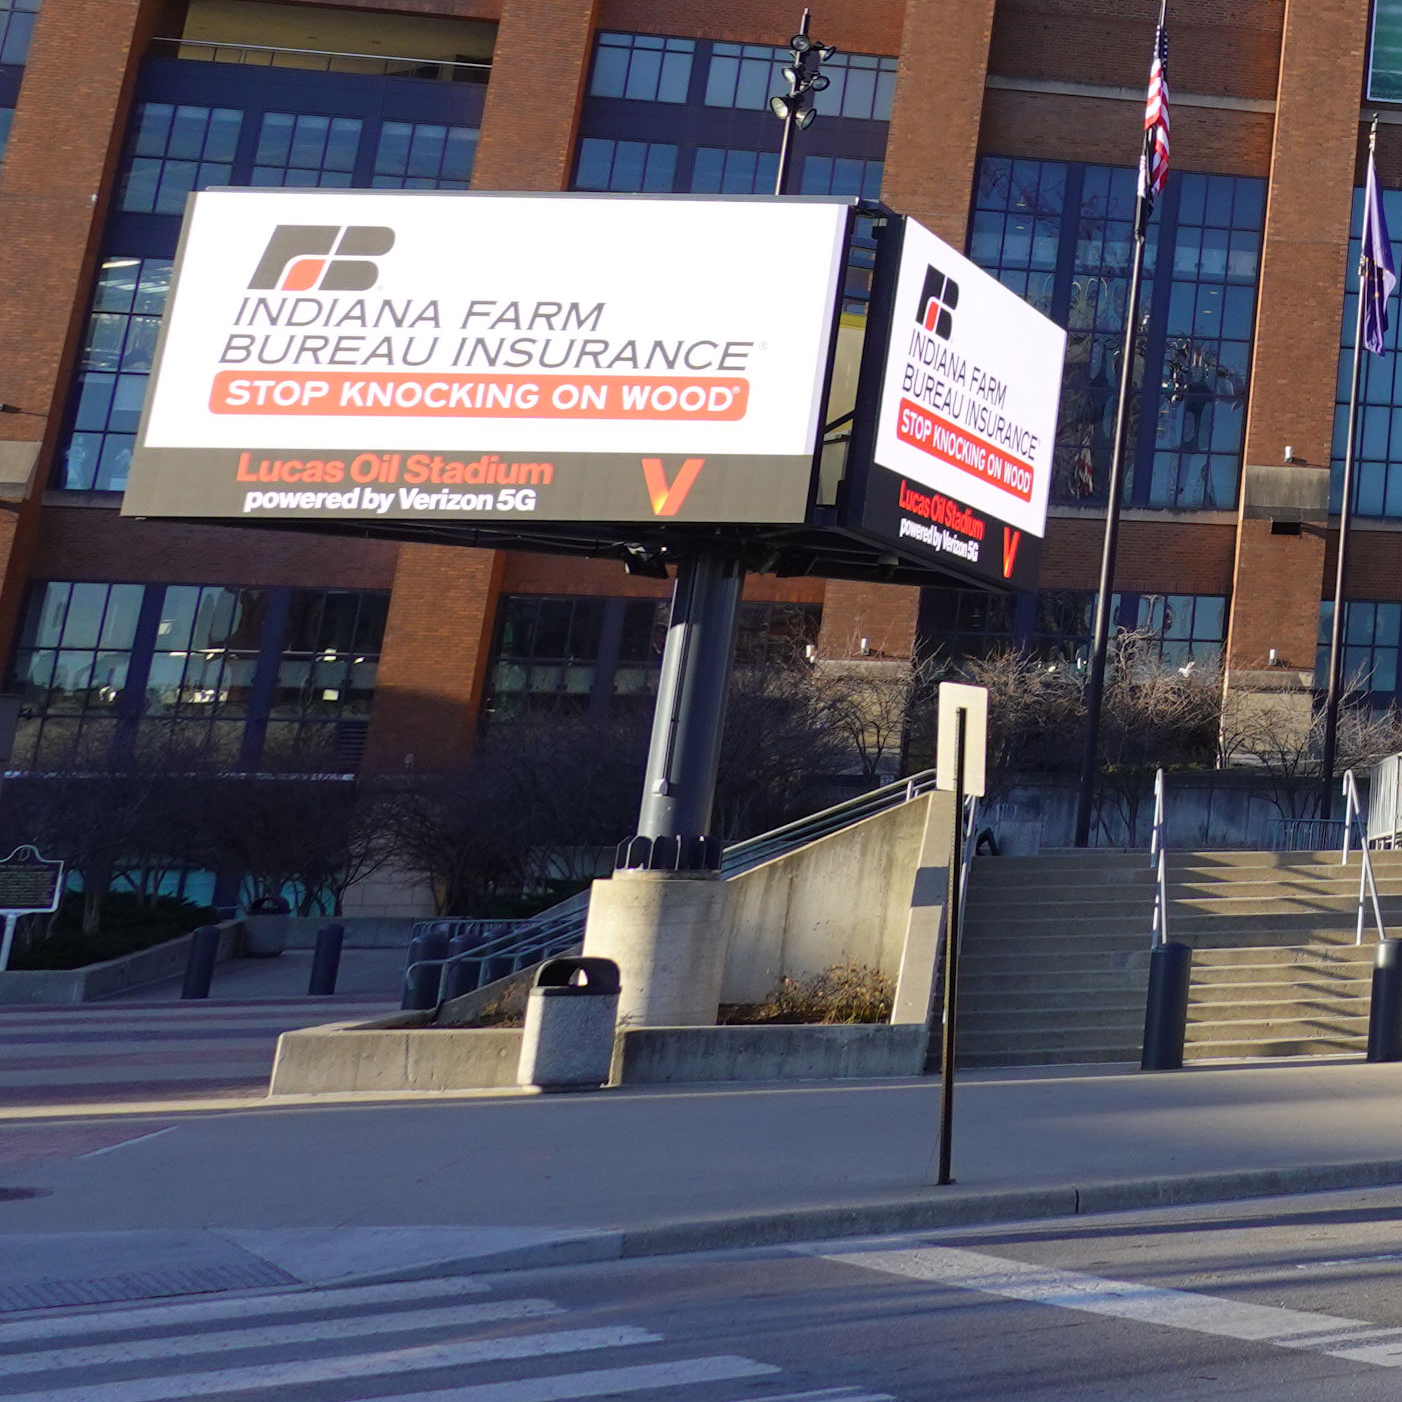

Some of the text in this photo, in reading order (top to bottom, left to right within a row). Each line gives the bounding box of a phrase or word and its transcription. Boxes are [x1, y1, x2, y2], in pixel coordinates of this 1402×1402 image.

[233, 297, 606, 331] INDIANA FARM
[218, 334, 440, 366] BUREAU
[909, 328, 1007, 410] INDIANA FARM
[225, 380, 329, 406] STOP
[339, 381, 539, 409] KNOCKING
[552, 384, 608, 410] ON
[902, 362, 964, 419] BUREAU
[901, 408, 932, 442] STOP
[932, 425, 986, 471] KNOCKING
[987, 453, 1002, 479] ON
[236, 452, 554, 485] Lucas Oil Stadium
[243, 487, 537, 513] powered by Verizon 5G
[898, 479, 985, 540] Lucas Oil Stadium
[899, 518, 979, 562] powered by Verizon 5G
